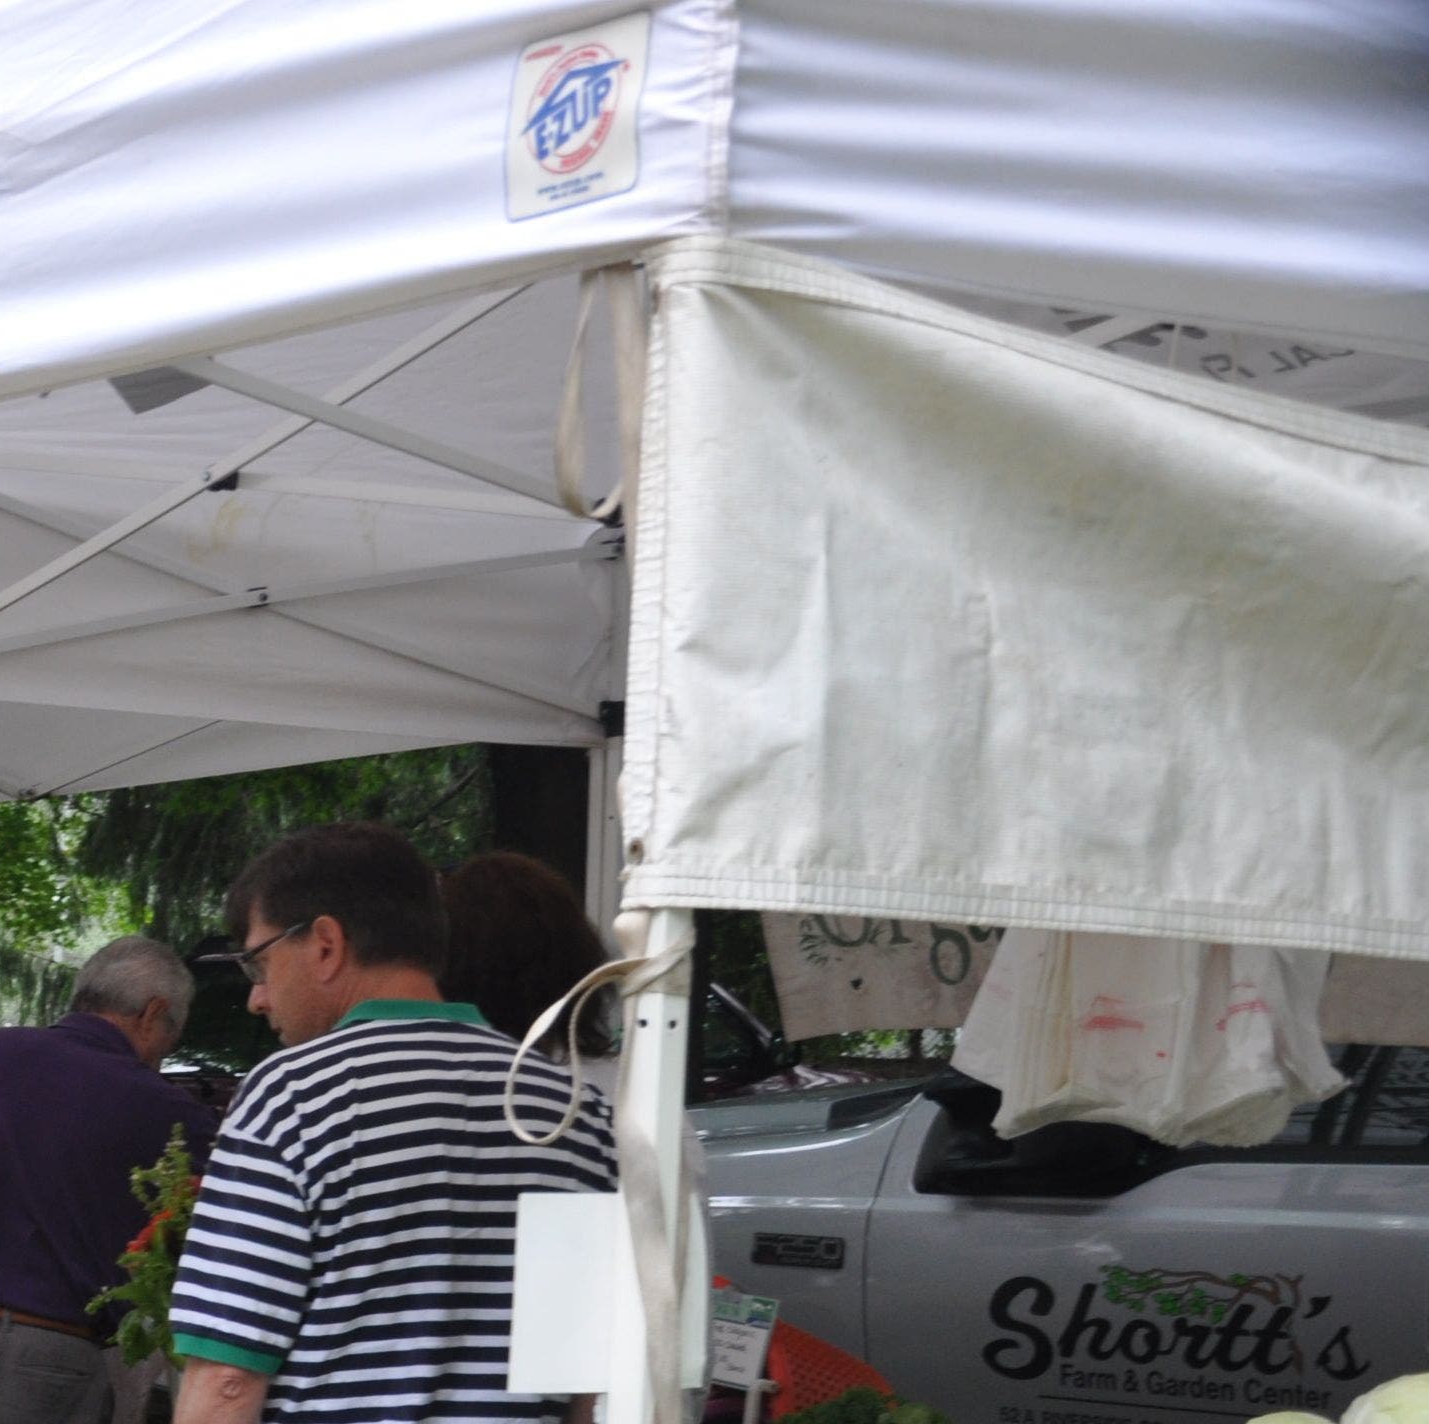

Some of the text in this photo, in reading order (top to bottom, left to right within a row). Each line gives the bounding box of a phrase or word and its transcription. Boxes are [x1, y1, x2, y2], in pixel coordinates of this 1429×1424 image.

[981, 1275, 1372, 1382] Shortt's
[1059, 1364, 1332, 1412] Farm & Garden Center
